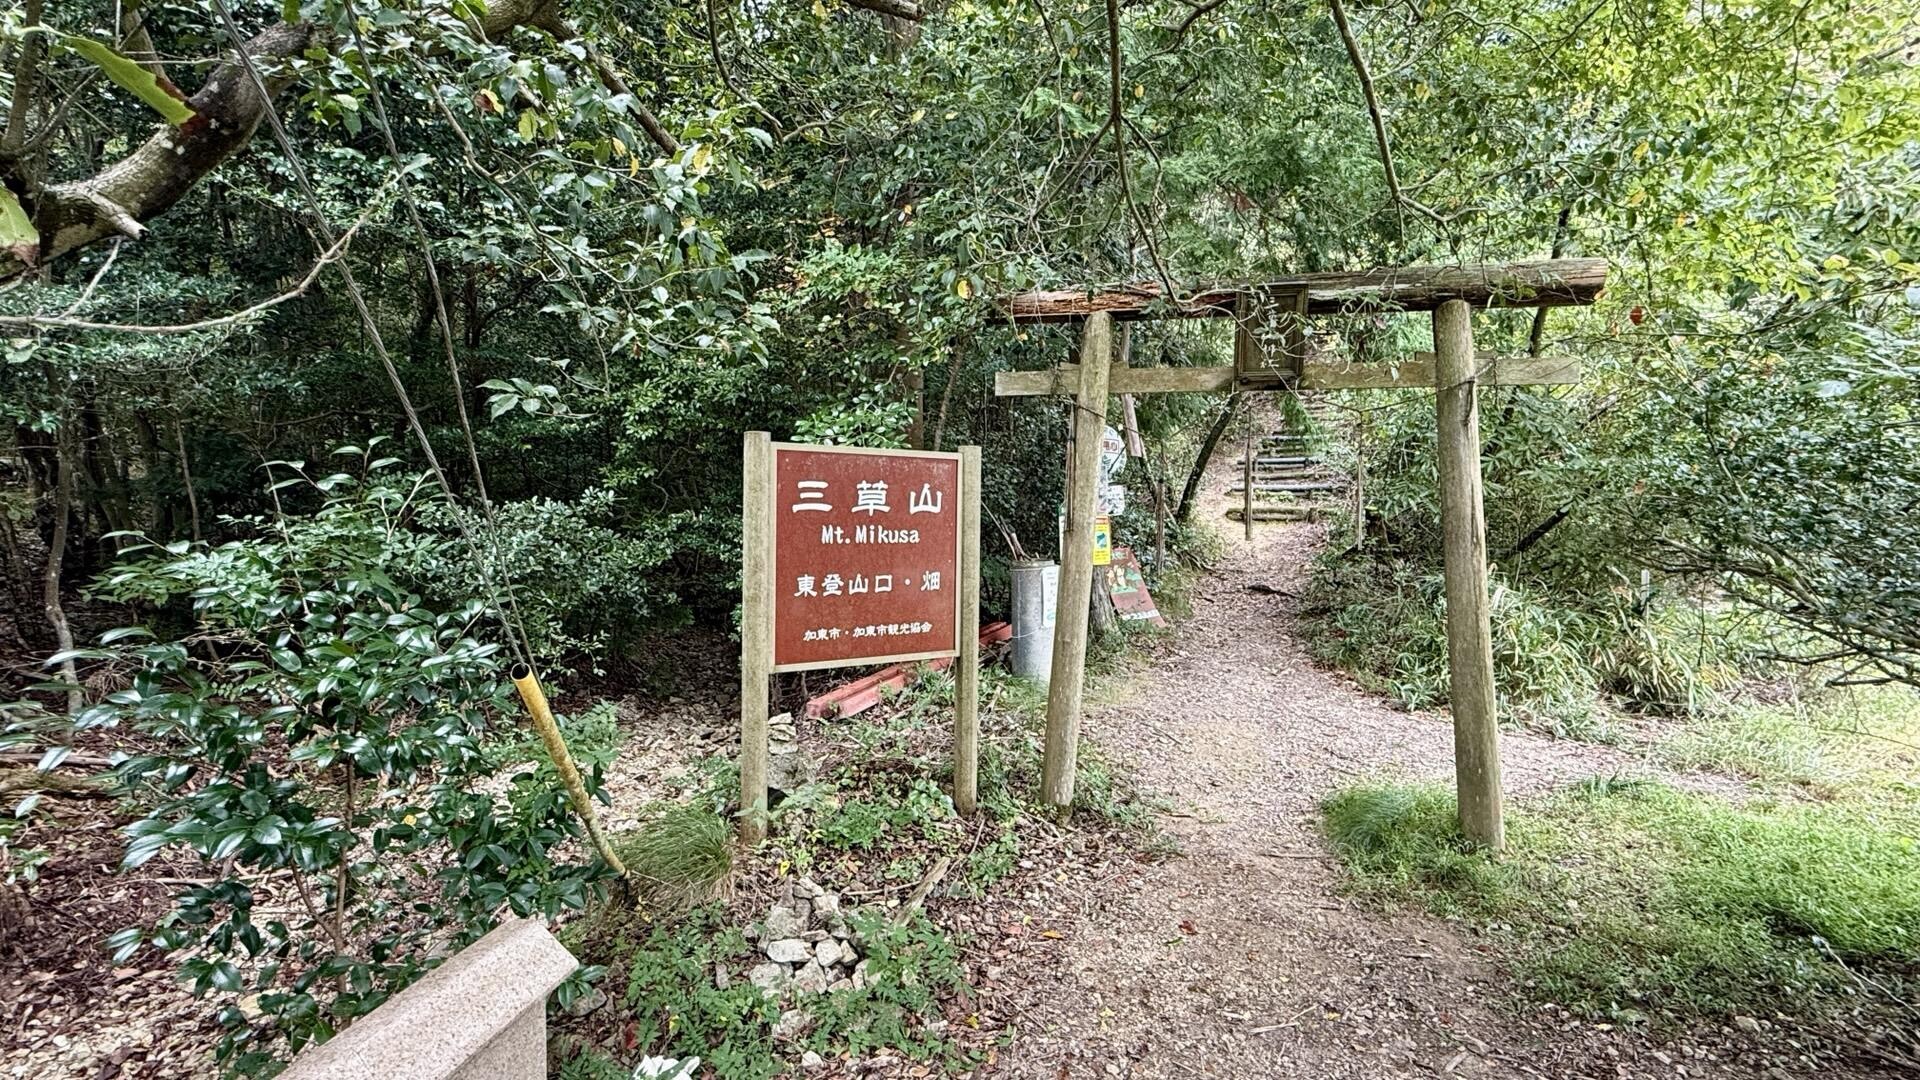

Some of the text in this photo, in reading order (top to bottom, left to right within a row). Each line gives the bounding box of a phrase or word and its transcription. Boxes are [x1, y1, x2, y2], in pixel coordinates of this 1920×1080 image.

[791, 478, 943, 517] 三草山
[821, 524, 921, 545] Mt.Mikusa
[793, 570, 942, 598] 東登山口・畑
[802, 622, 933, 642] 加東市・加東市観光協会
